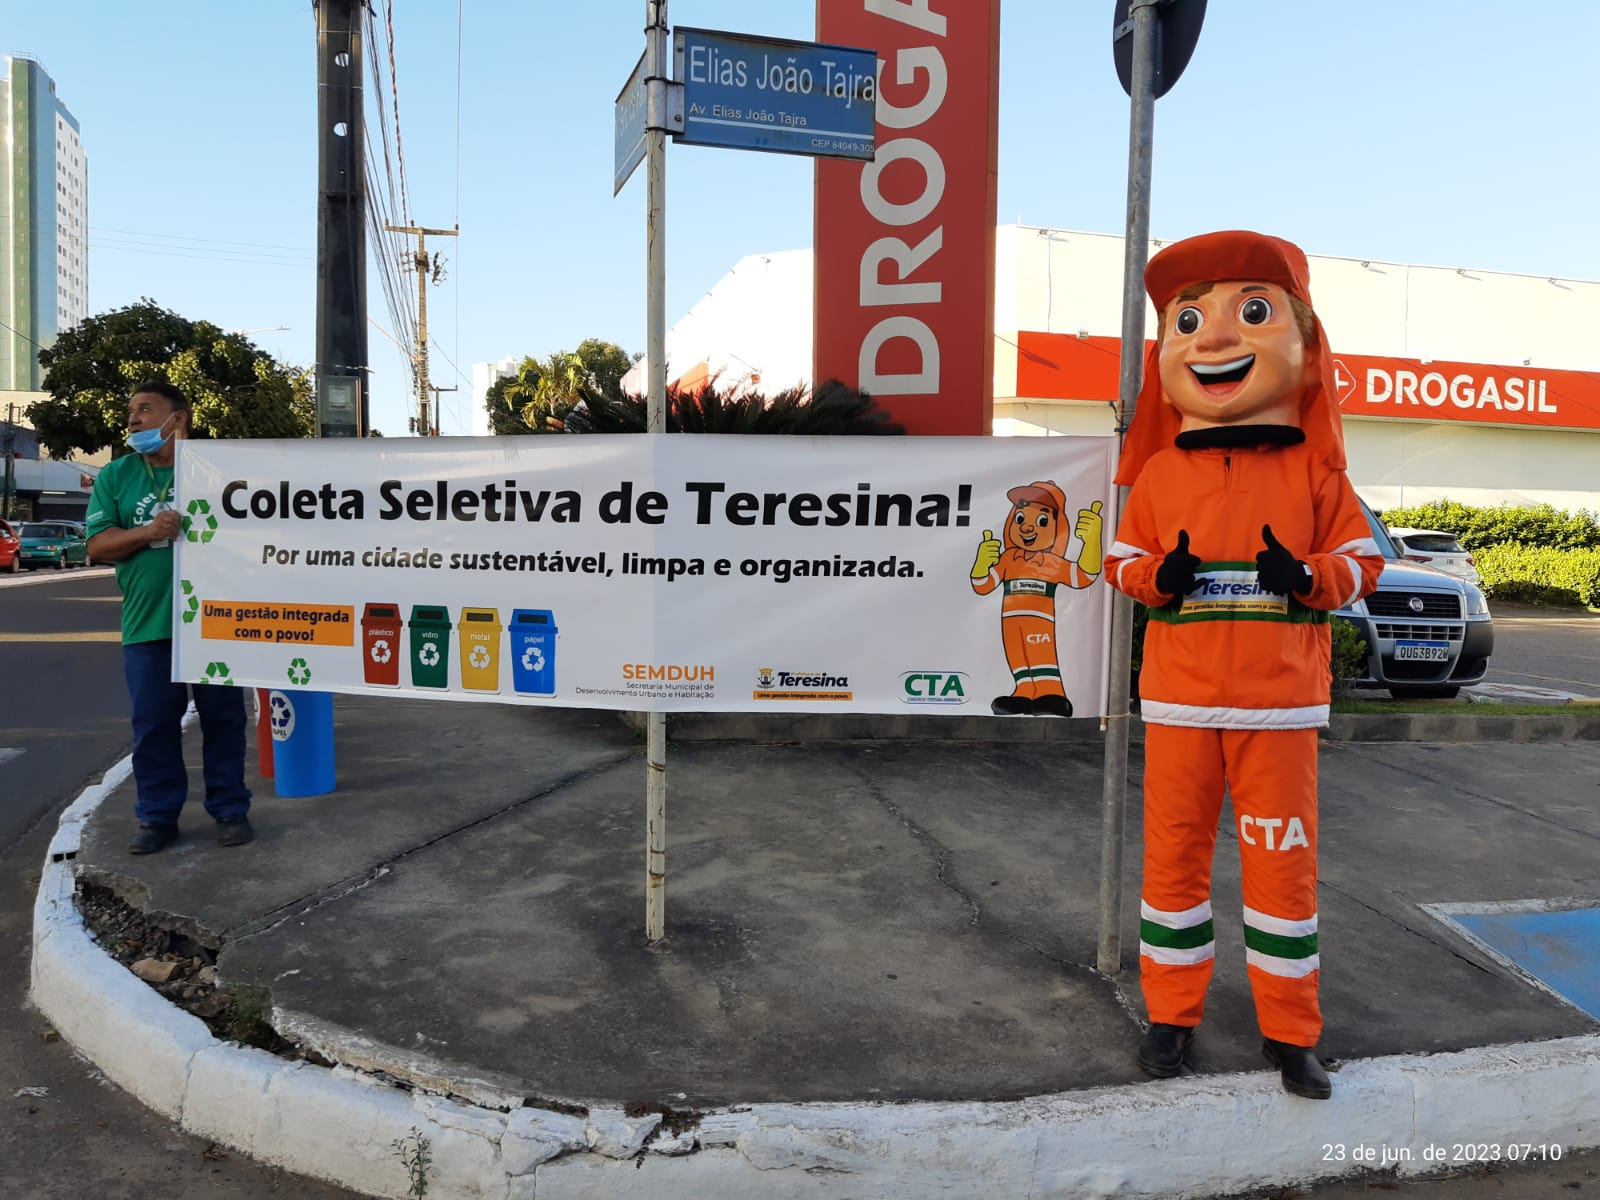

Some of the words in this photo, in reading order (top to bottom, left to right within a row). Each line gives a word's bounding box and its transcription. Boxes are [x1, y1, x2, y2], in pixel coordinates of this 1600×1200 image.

[690, 46, 748, 88] Elias
[756, 54, 813, 94] João
[821, 61, 876, 109] Tajra
[690, 102, 708, 115] Av.
[712, 105, 742, 119] Elias
[746, 109, 775, 122] João
[778, 111, 807, 127] Tajra
[811, 138, 830, 149] CEP
[1366, 368, 1557, 413] DROGASIL
[133, 492, 158, 525] Colet
[222, 480, 365, 520] Coleta
[379, 480, 582, 523] Seletiva
[598, 481, 669, 524] de
[685, 482, 973, 528] Teresina!
[262, 544, 300, 564] Por
[305, 548, 355, 566] uma
[362, 546, 443, 569] cidade
[449, 551, 614, 578] sustentável,
[622, 552, 705, 582] limpa
[714, 558, 731, 576] e
[739, 555, 924, 584] organizada.
[204, 605, 233, 618] Uma
[235, 607, 279, 622] gestão
[282, 608, 349, 625] integrada
[234, 628, 261, 638] com
[264, 629, 273, 639] o
[276, 629, 315, 643] povo!
[368, 628, 394, 637] plástico
[422, 631, 439, 639] vidro
[470, 633, 491, 641] metal
[524, 635, 545, 645] papel
[1026, 633, 1051, 643] CTA
[623, 664, 715, 681] SEMDUH
[777, 672, 849, 687] Teresina
[575, 686, 638, 697] Desenvolvimento
[639, 690, 667, 698] Urbano
[674, 690, 715, 700] Habitação
[626, 682, 662, 690] Secretaria
[665, 682, 703, 692] Municipal
[704, 683, 714, 691] de
[904, 674, 965, 696] CTA
[1239, 814, 1309, 851] CTA
